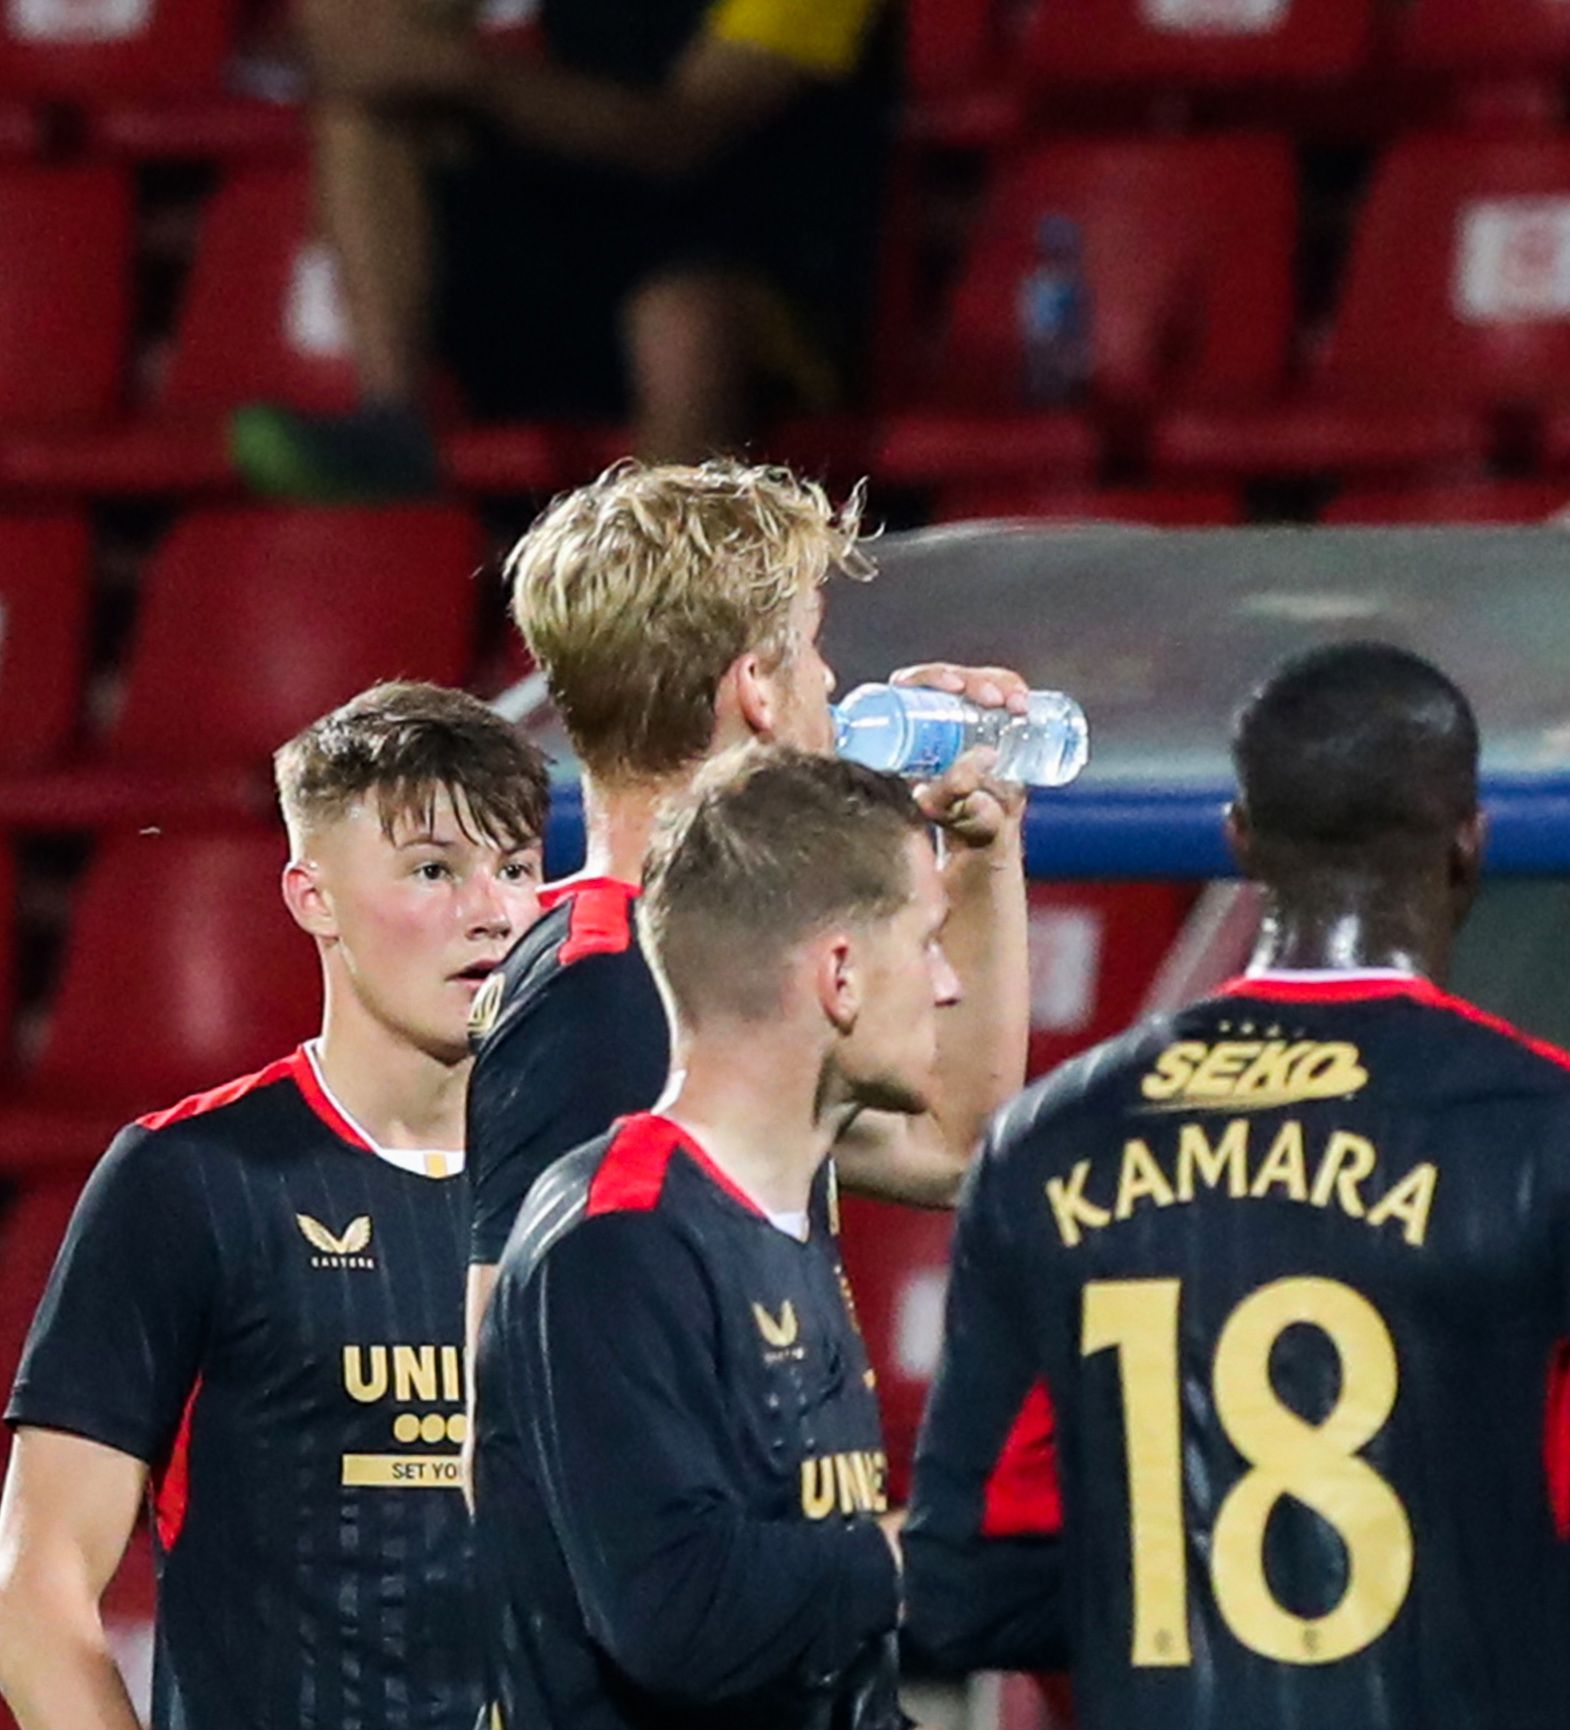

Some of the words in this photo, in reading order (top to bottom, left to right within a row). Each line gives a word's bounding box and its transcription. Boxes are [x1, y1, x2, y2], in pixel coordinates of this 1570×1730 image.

[1140, 1040, 1369, 1103] SEKO
[1044, 1118, 1438, 1247] KAMARA
[392, 1462, 425, 1480] SET
[1080, 1274, 1415, 1667] 18
